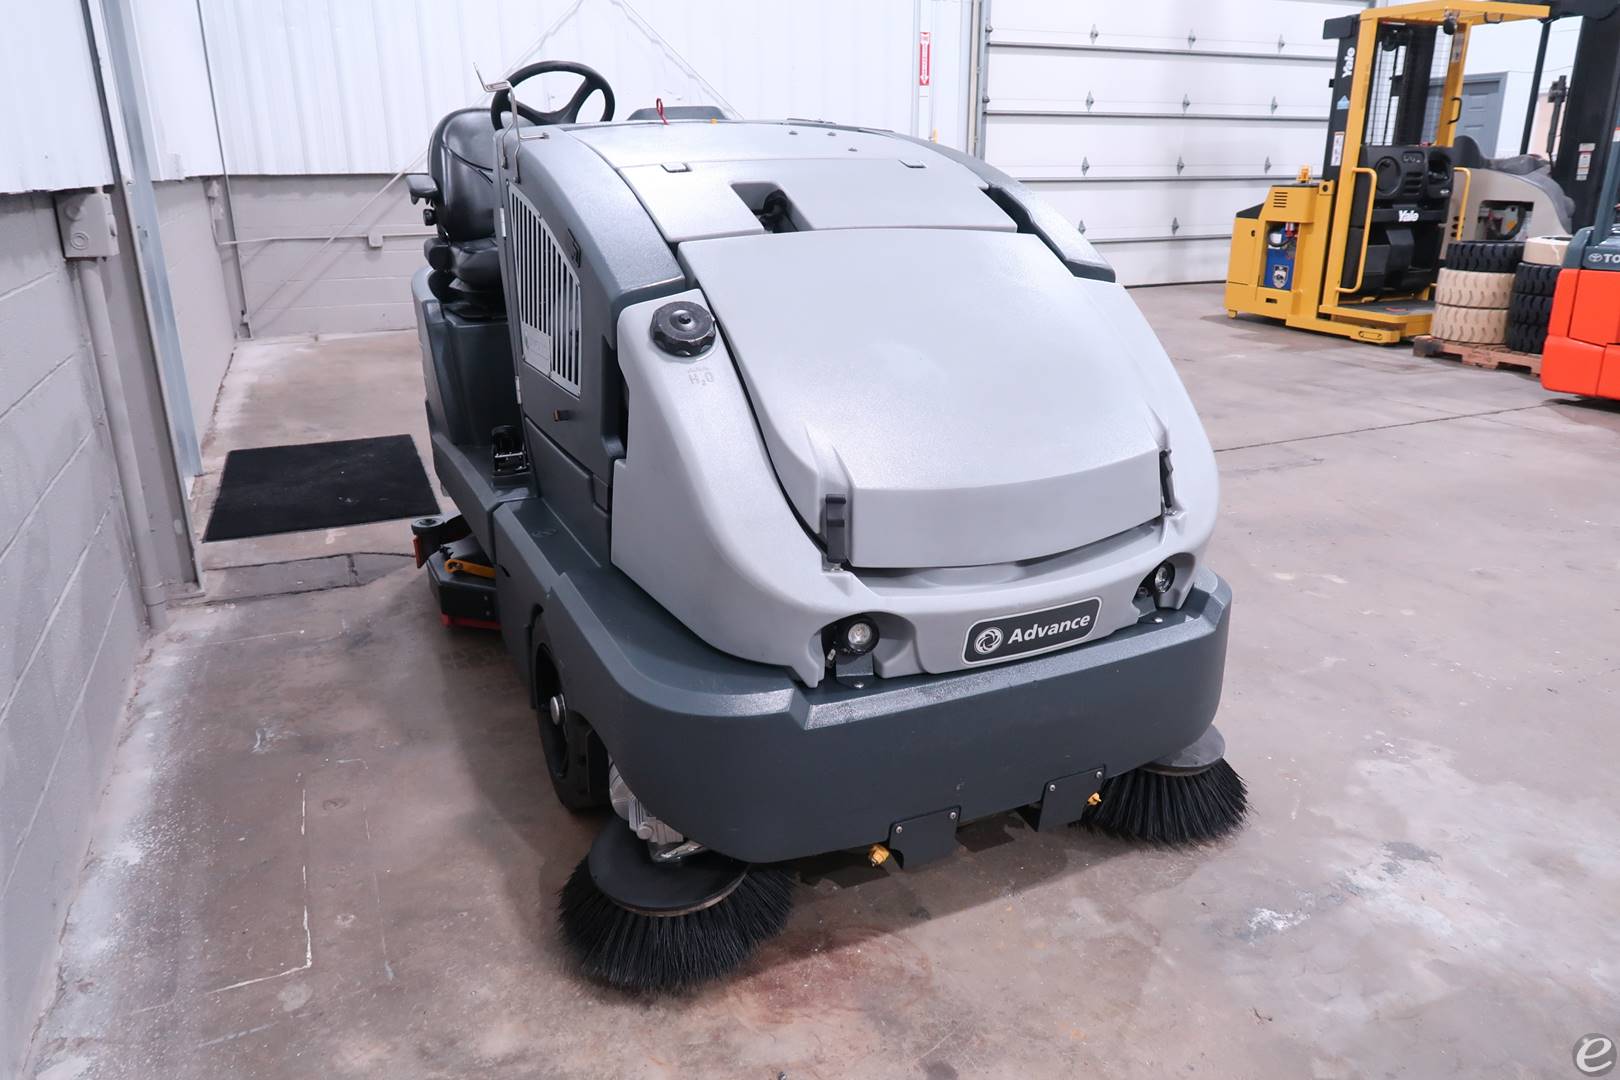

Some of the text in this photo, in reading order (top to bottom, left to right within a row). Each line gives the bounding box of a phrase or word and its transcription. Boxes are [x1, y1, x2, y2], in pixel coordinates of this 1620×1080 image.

[1342, 47, 1355, 78] Yale
[1398, 210, 1419, 222] Yale
[1008, 615, 1090, 644] Advance
